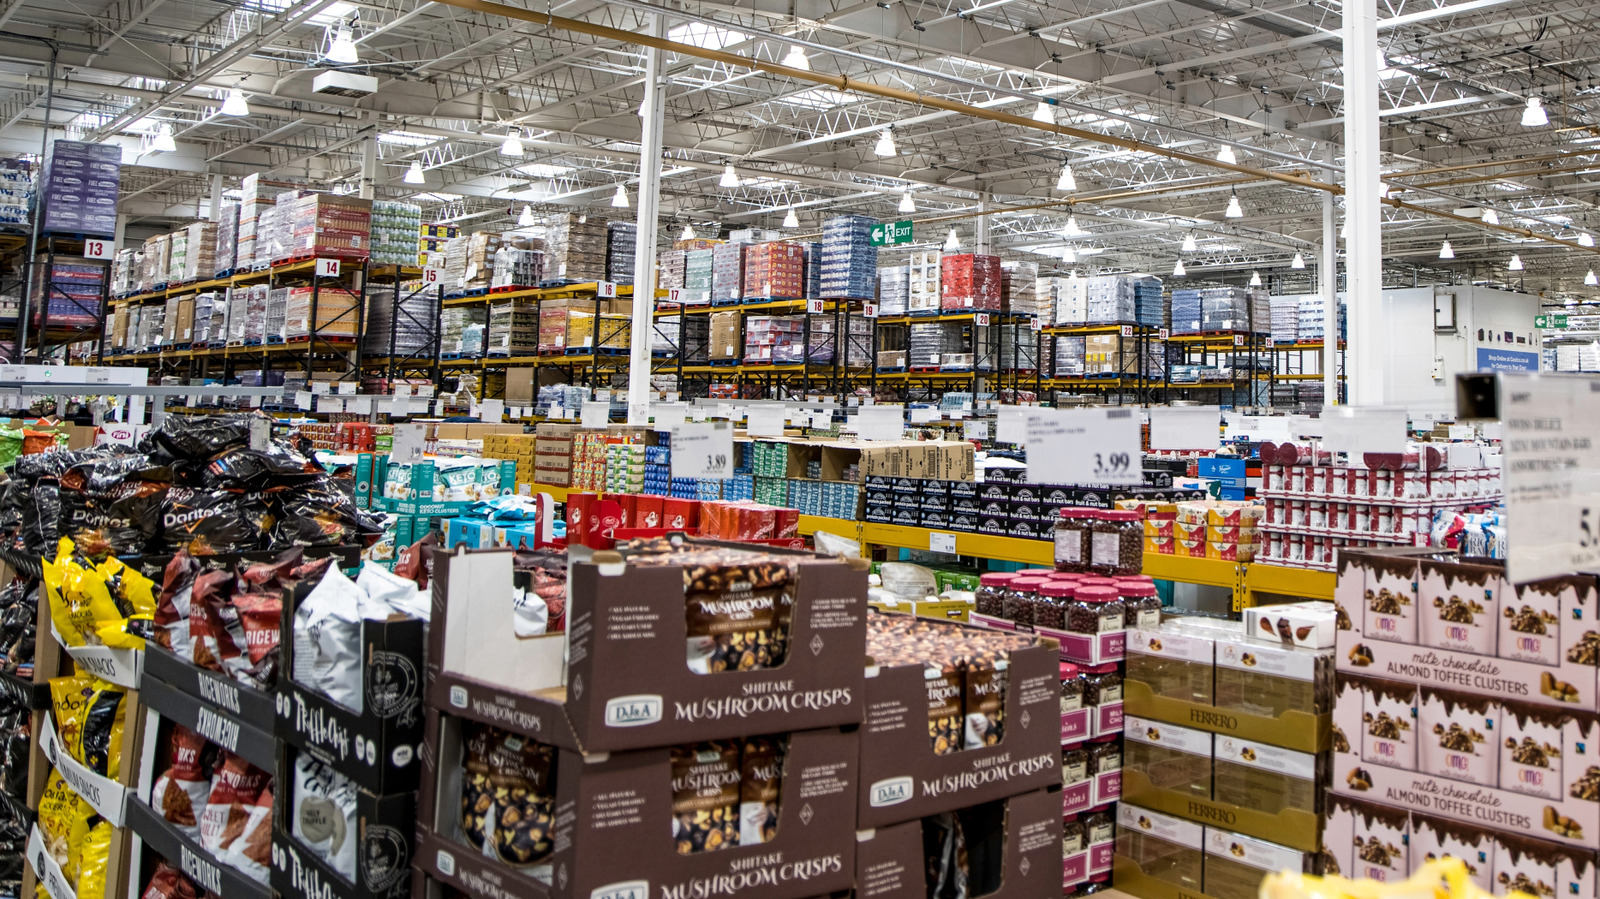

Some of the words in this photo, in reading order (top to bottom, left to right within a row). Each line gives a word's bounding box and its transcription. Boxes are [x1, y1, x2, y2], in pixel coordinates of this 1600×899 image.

[896, 226, 911, 237] EXIT
[88, 242, 103, 256] 13
[326, 262, 337, 274] 14
[426, 270, 436, 282] 15
[605, 284, 612, 295] 16
[671, 290, 679, 300] 17
[814, 301, 822, 311] 18
[865, 305, 873, 316] 19
[980, 315, 988, 325] 20
[1032, 318, 1038, 328] 21
[1124, 326, 1132, 335] 22
[1160, 329, 1166, 338] 23
[1237, 336, 1243, 344] 24
[1266, 338, 1272, 346] 25
[1532, 439, 1571, 450] MOUNTAIN
[707, 455, 726, 470] 3.89
[1094, 452, 1130, 473] 3.99
[449, 470, 475, 484] KETO
[73, 509, 130, 528] Doritos
[164, 502, 222, 528] Doritos
[1580, 508, 1600, 548] 5.
[699, 597, 774, 615] MUSHROOM
[730, 611, 754, 620] CRISPS
[1376, 616, 1396, 633] OMG!
[246, 630, 280, 645] RICEW
[1446, 626, 1468, 642] OMG!
[1516, 637, 1541, 653] OMG!
[90, 655, 115, 677] SNACKS
[1412, 651, 1441, 666] milk
[1442, 655, 1501, 675] chocolate
[1388, 662, 1430, 679] ALMOND
[1434, 669, 1471, 686] TOFFEE
[1474, 675, 1529, 696] CLUSTERS
[198, 672, 240, 715] RICEWORKS
[742, 680, 794, 696] SHIITAKE
[675, 692, 789, 723] MUSHROOM
[791, 688, 852, 710] CRISPS
[473, 697, 513, 723] MUSHROOM
[513, 711, 541, 731] CRISPS
[1190, 708, 1237, 730] FERRERO
[1374, 741, 1395, 757] OMG!
[690, 762, 729, 774] SHIITAKE
[1445, 754, 1468, 771] OMG!
[221, 769, 261, 788] EWORKS
[922, 766, 1009, 796] MUSHROOM
[1009, 754, 1054, 777] CRISPS
[1518, 768, 1543, 786] OMG!
[1412, 779, 1441, 794] milk
[1443, 786, 1502, 807] chocolate
[1189, 802, 1236, 825] FERRERO
[1387, 788, 1430, 806] ALMOND
[1434, 796, 1472, 816] TOFFEE
[1475, 806, 1531, 829] CLUSTERS
[729, 851, 784, 873] SHIITAKE
[181, 846, 221, 896] RICEWORKS
[661, 867, 779, 899] MUSHROOM
[780, 854, 843, 882] CRISPS
